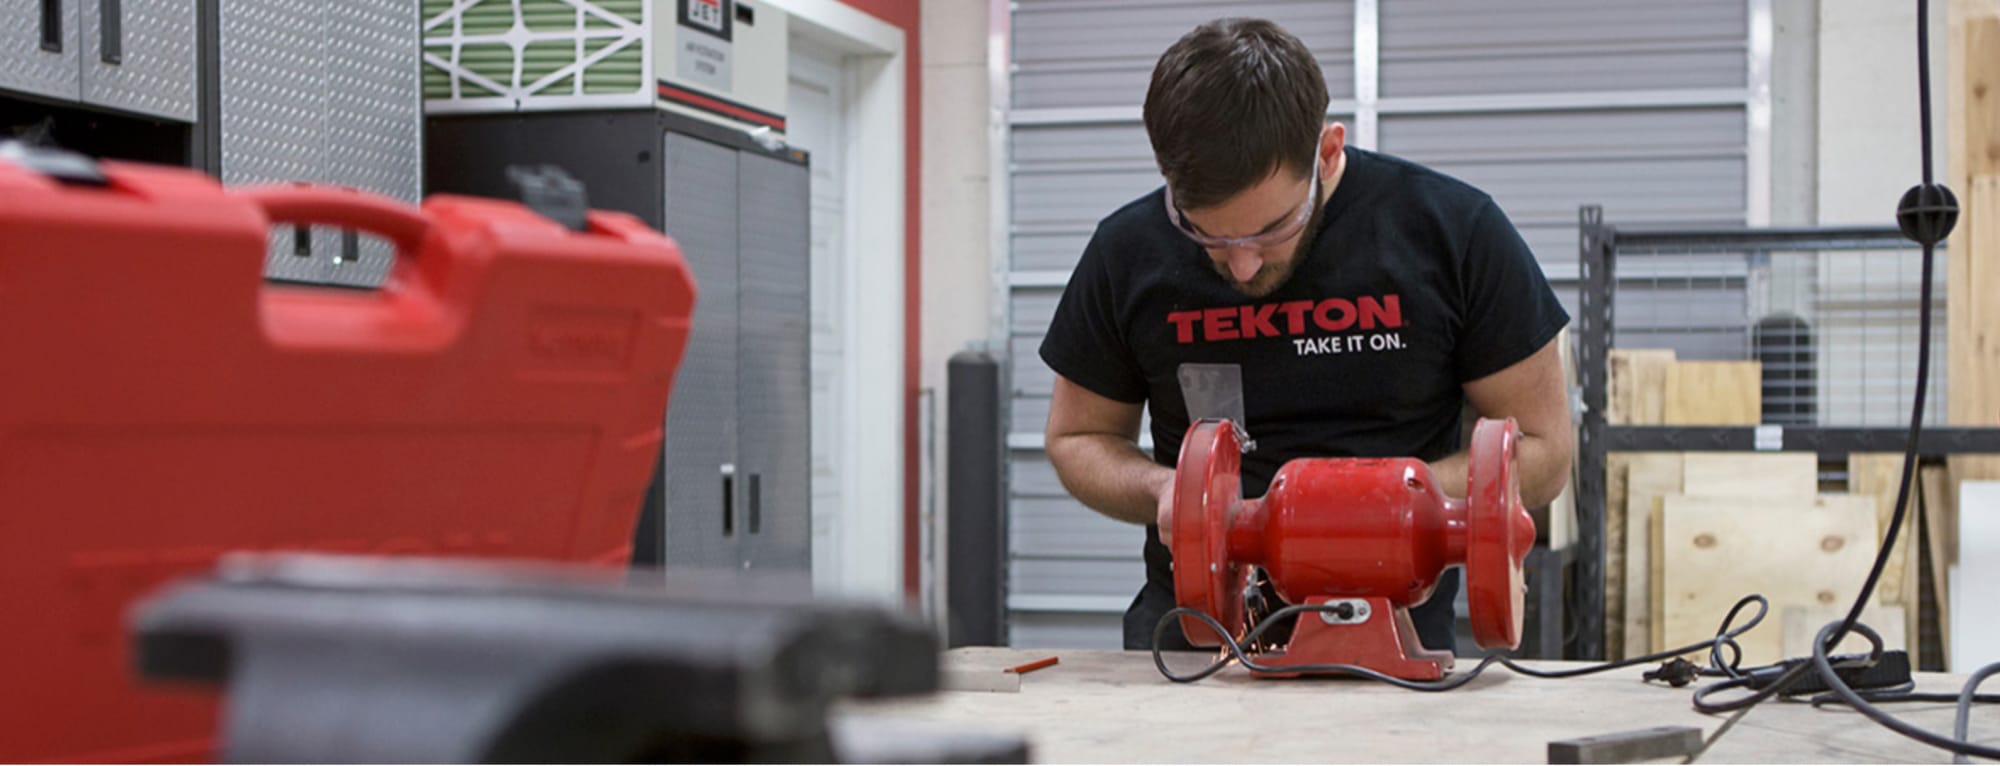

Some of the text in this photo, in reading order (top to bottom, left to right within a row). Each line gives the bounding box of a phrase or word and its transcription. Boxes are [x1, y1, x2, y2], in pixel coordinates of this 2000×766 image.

[1167, 294, 1403, 343] TEKTON
[1293, 333, 1407, 355] TAKE IT ON.
